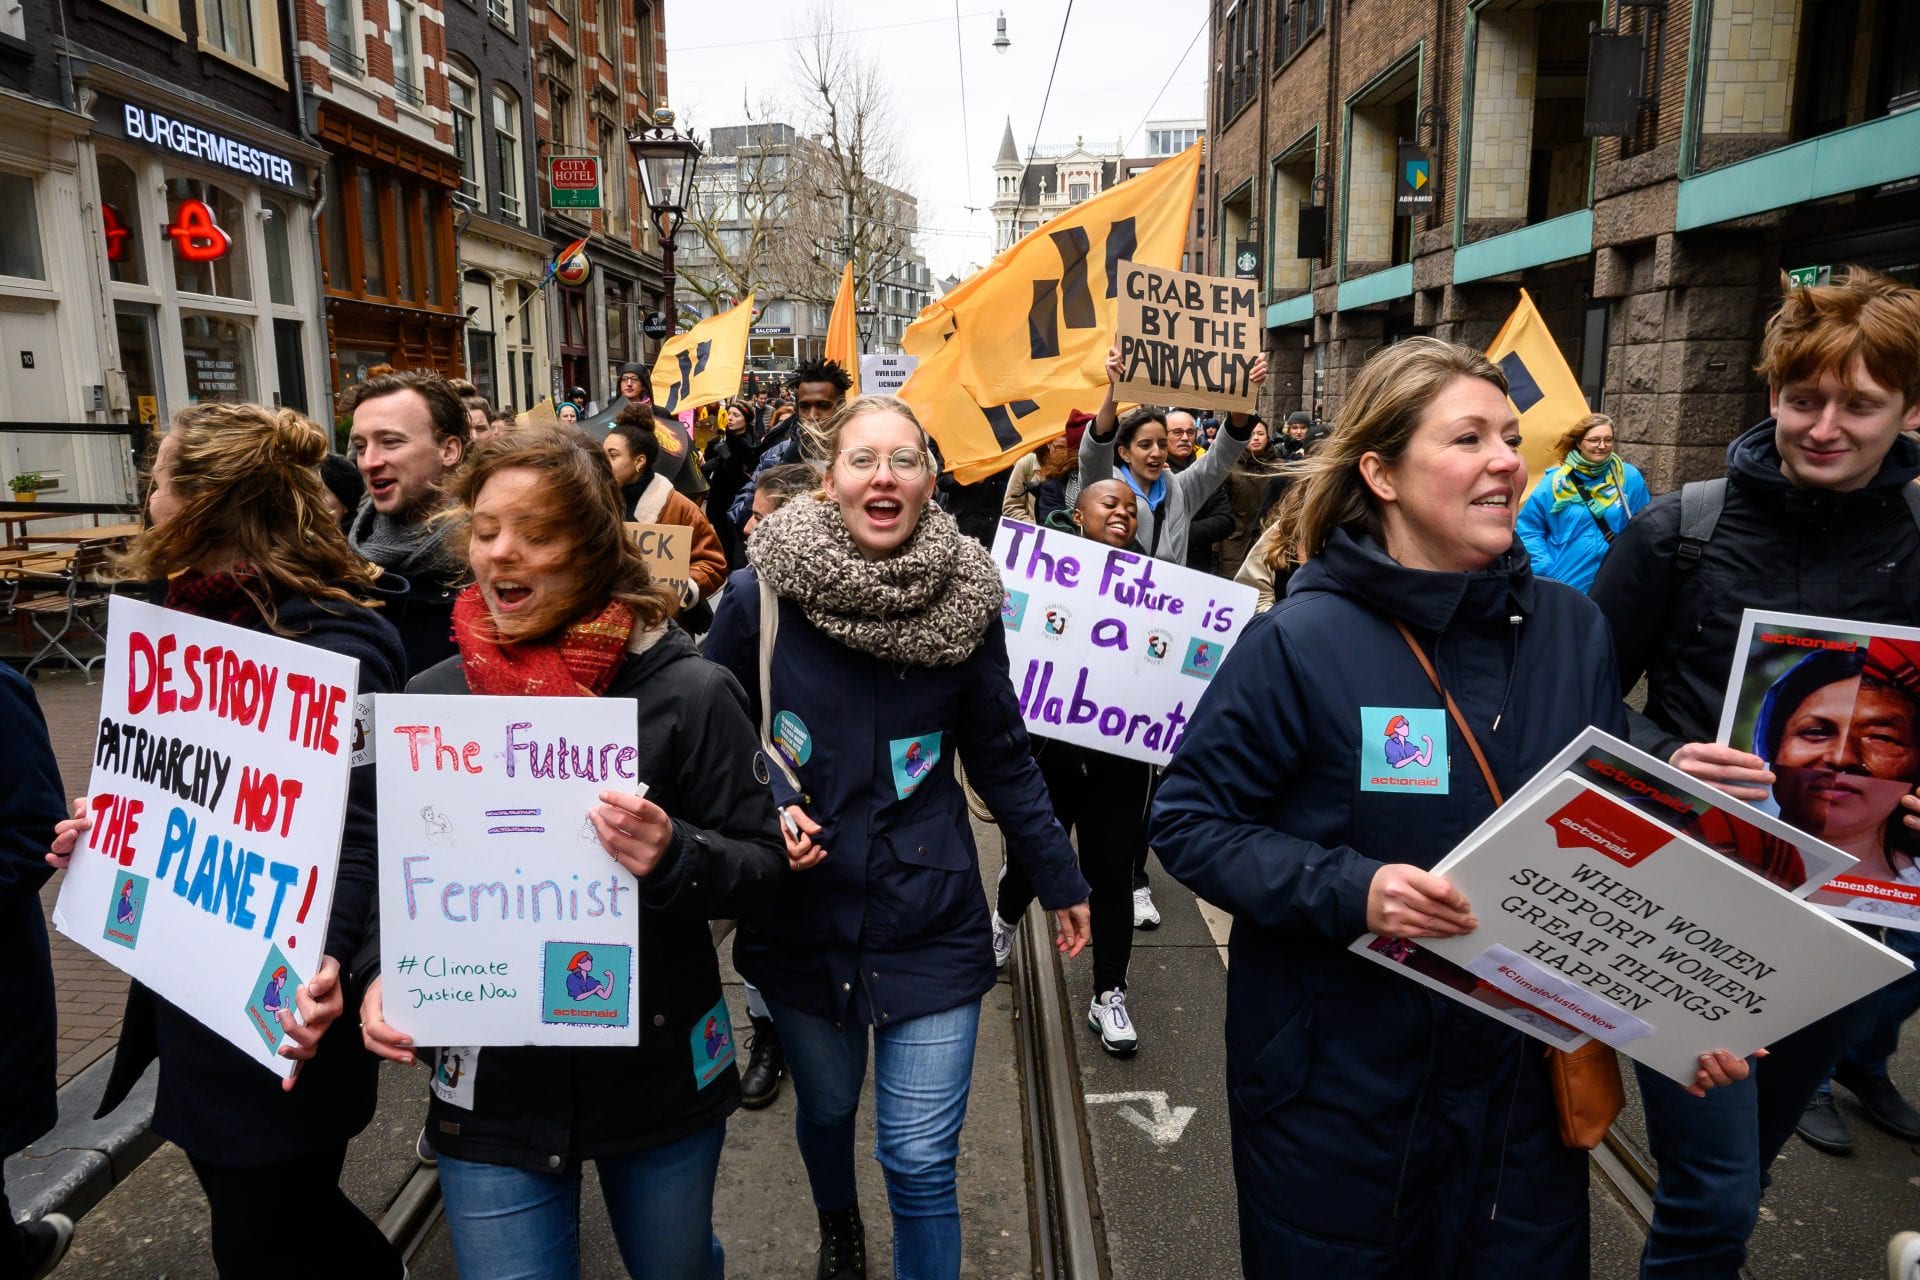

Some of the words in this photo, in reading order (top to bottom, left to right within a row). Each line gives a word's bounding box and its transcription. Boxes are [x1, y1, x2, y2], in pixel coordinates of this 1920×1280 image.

[124, 103, 294, 187] BURGERMEESTER
[555, 170, 594, 181] HOTEL
[560, 160, 588, 170] CITY
[572, 190, 578, 199] 2
[1126, 270, 1205, 311] GRAB
[1209, 283, 1255, 318] 'EM
[1141, 305, 1181, 340] BY
[1189, 316, 1246, 350] THE
[23, 354, 33, 365] 10
[1119, 335, 1258, 398] PATRIARCHY
[633, 530, 674, 560] CK
[1001, 518, 1081, 588] The
[1098, 550, 1186, 615] Future
[1201, 598, 1235, 633] is
[1091, 617, 1130, 652] a
[127, 631, 279, 733] DESTROY
[286, 671, 347, 756] THE
[1020, 659, 1188, 754] llaborat
[96, 716, 232, 814] PATRIARCHY
[233, 765, 304, 838] NOT
[393, 725, 484, 774] The
[506, 722, 638, 783] Future
[88, 793, 145, 867] THE
[155, 806, 319, 949] PLANET!
[403, 855, 630, 923] Feminist
[1509, 868, 1657, 949] SUPPORT
[1656, 946, 1768, 1016] WOMEN,
[1570, 863, 1665, 920] WHEN
[1664, 915, 1777, 981] WOMEN
[1500, 895, 1610, 957] GREAT
[1608, 953, 1731, 1022] THINGS
[1523, 939, 1652, 1011] HAPPEN
[1496, 965, 1617, 1031] #ClimateJusticeNow
